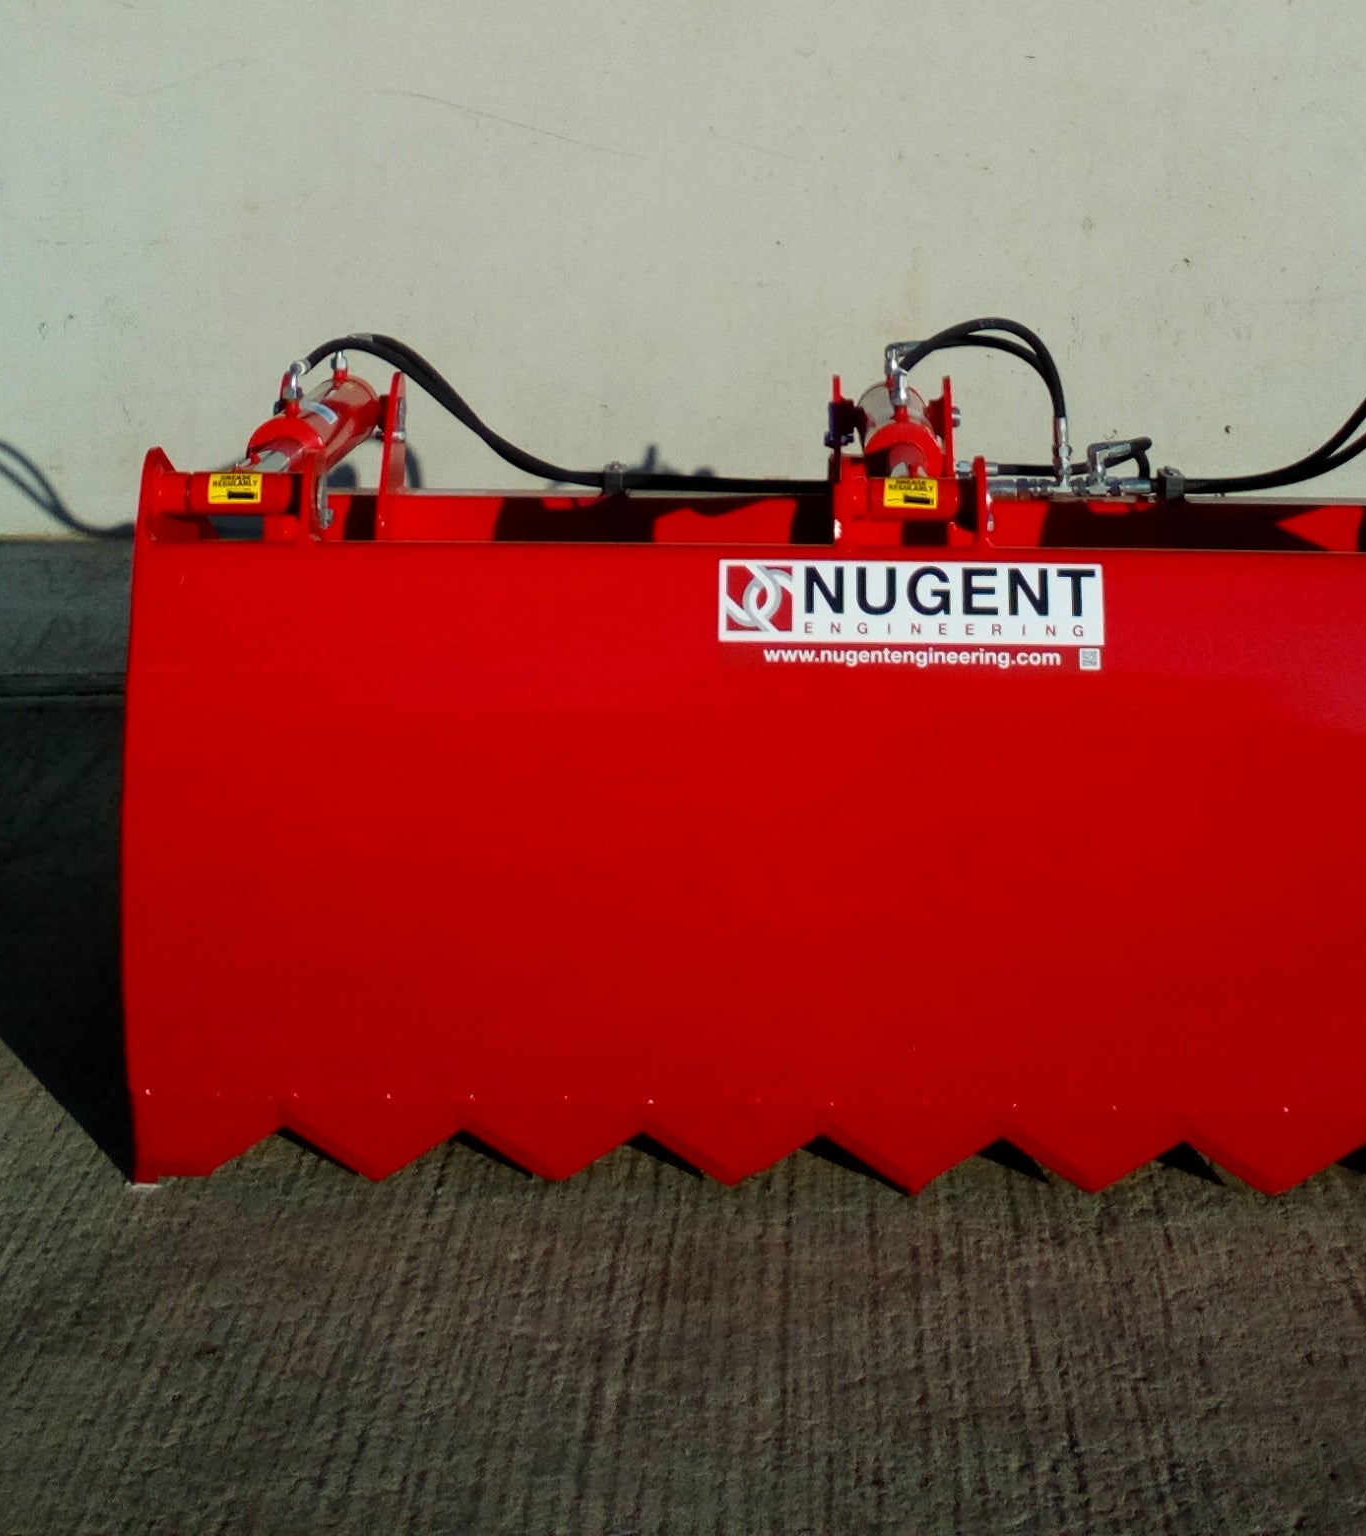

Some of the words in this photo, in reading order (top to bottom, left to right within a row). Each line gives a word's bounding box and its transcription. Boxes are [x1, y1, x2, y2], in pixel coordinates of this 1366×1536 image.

[804, 565, 1096, 617] NUGENT
[803, 621, 1085, 637] ENGINEERING
[764, 647, 1062, 668] www.nugentengineering.com
